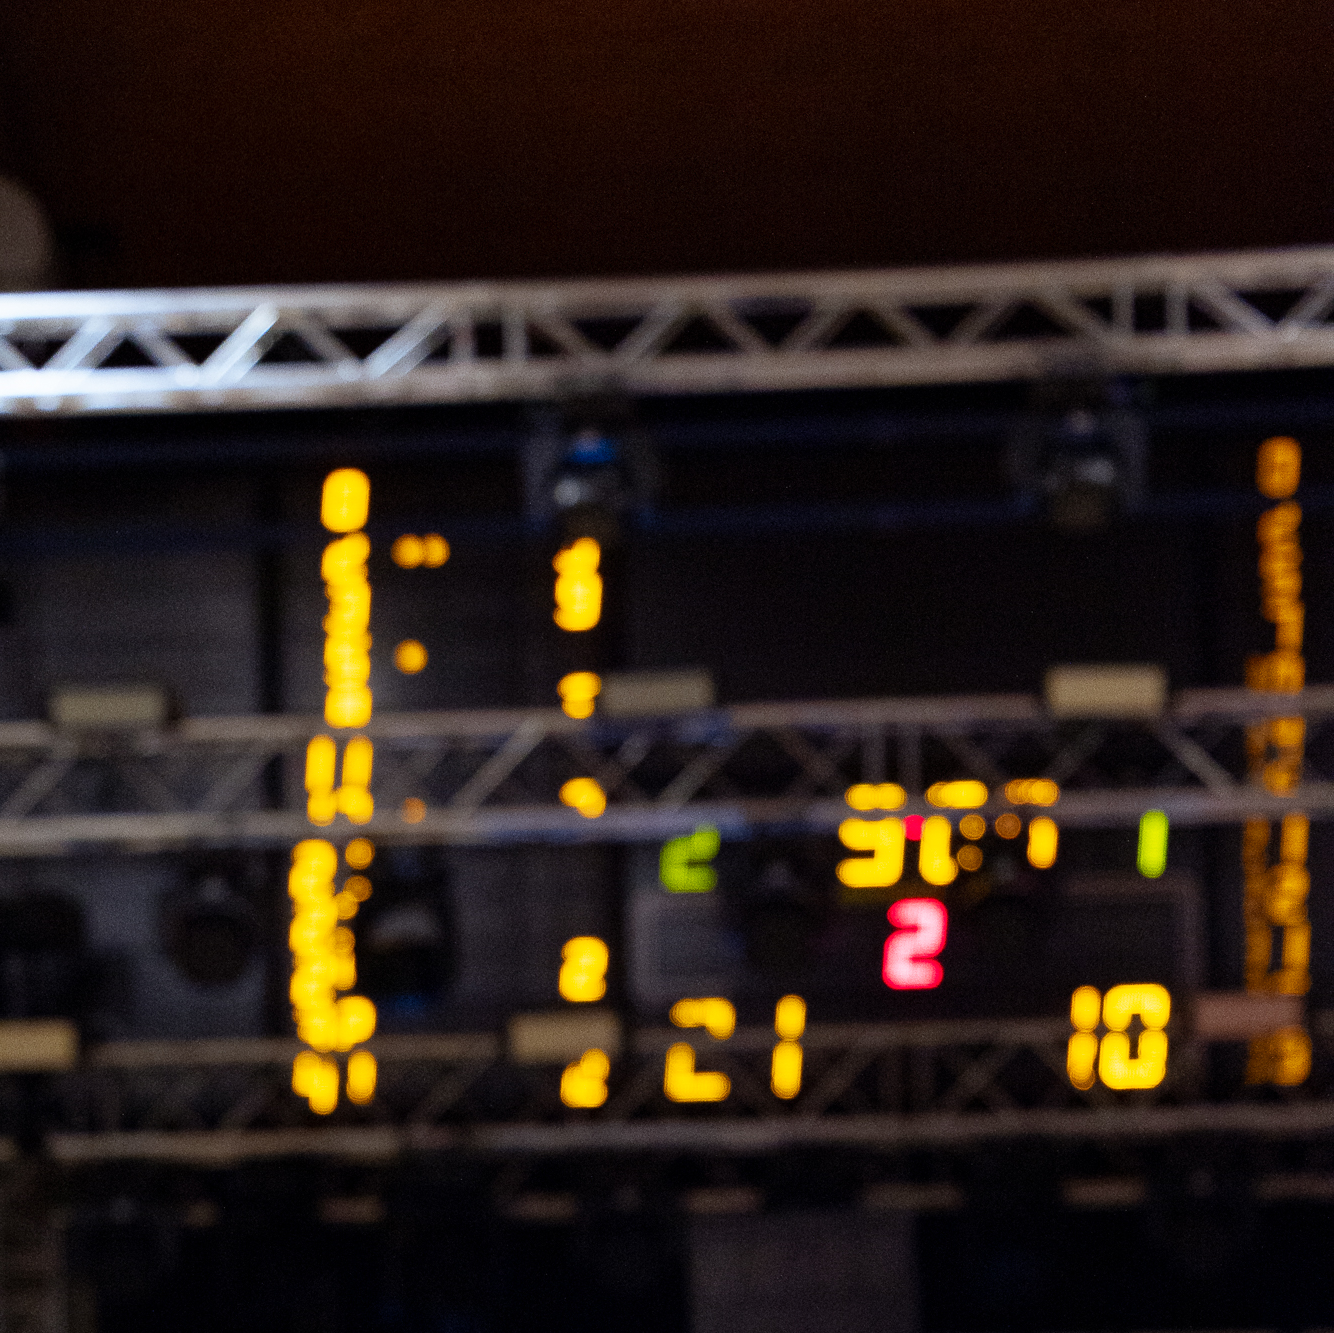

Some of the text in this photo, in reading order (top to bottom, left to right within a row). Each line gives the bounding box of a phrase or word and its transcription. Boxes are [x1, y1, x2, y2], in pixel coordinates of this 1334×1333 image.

[882, 897, 949, 990] 2
[663, 996, 807, 1102] 21
[1066, 983, 1170, 1090] 10
